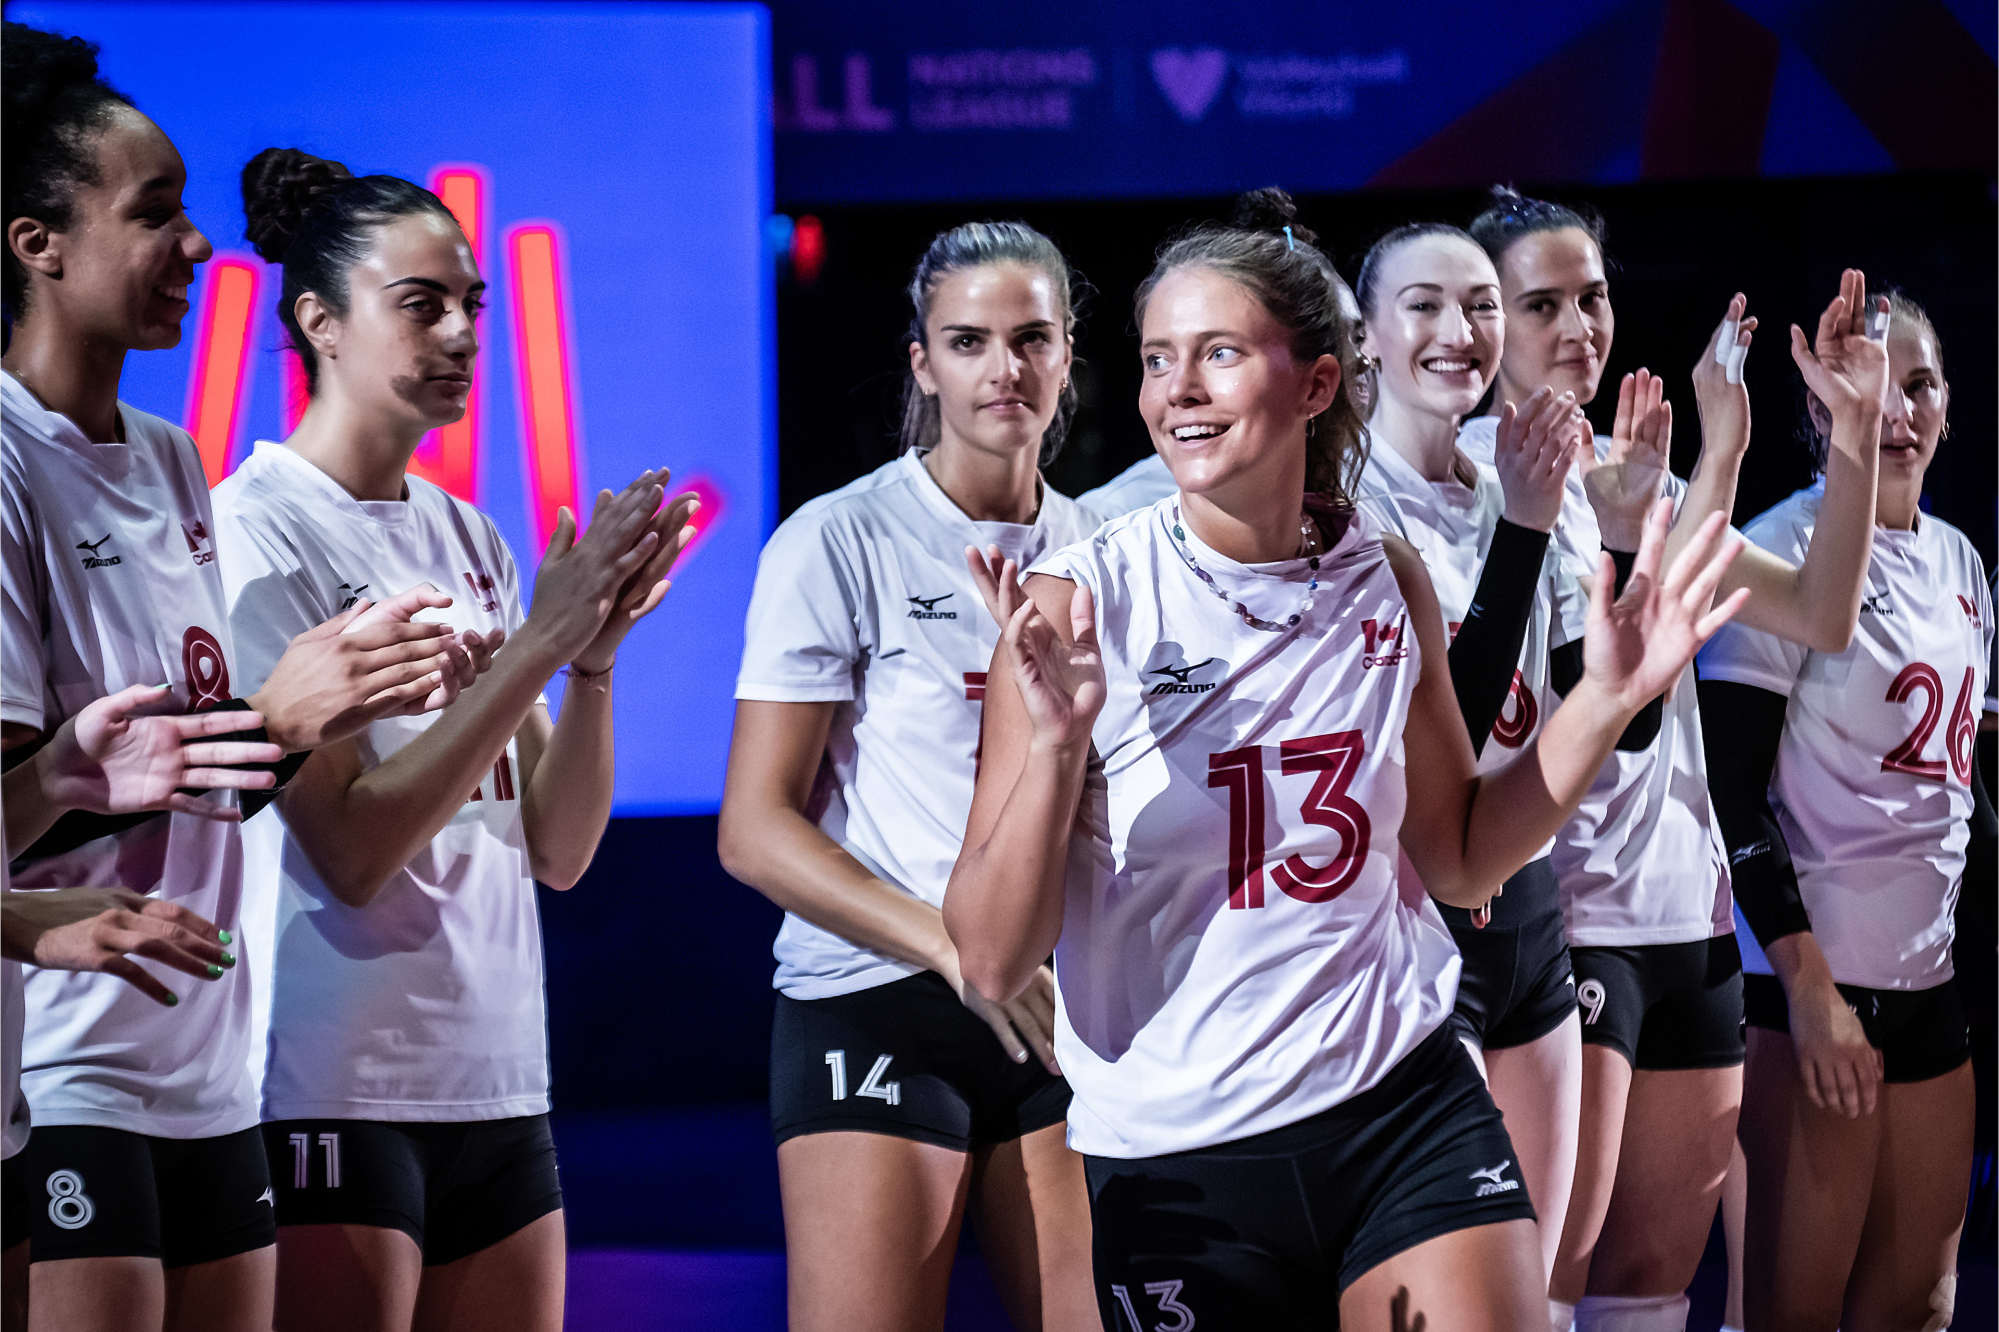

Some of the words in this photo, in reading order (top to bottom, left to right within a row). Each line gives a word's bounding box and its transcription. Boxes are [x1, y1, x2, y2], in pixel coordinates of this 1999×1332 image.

[773, 54, 893, 131] LL
[1880, 661, 1976, 786] 26
[1207, 729, 1372, 910] 13
[1577, 978, 1606, 1025] 9
[824, 1048, 901, 1106] 14
[288, 1132, 341, 1189] 11
[46, 1169, 95, 1230] 8
[1110, 1279, 1196, 1332] 13
